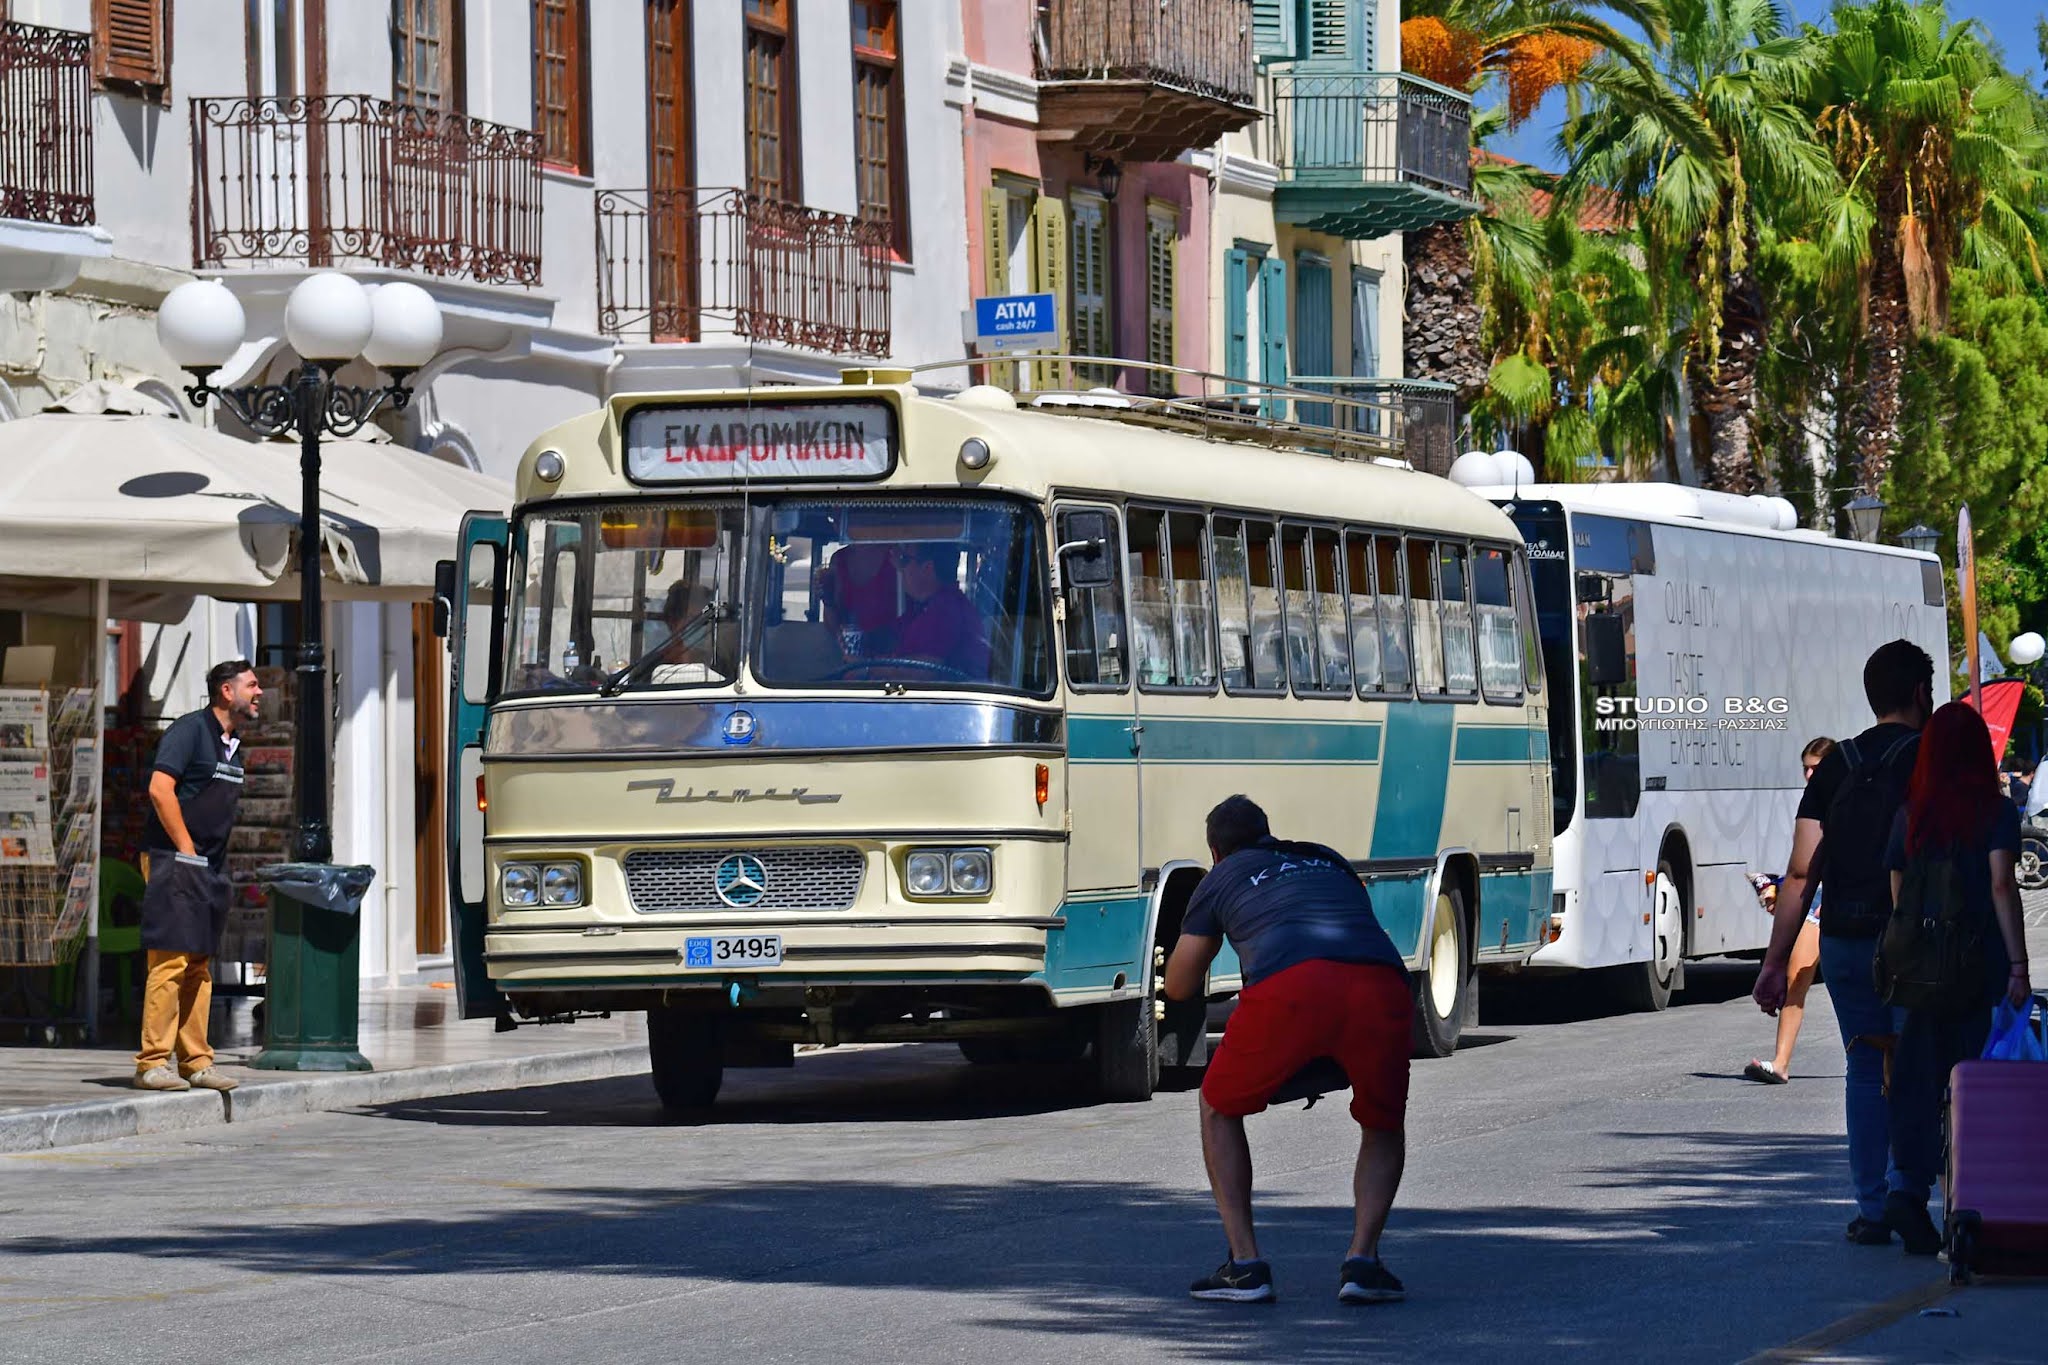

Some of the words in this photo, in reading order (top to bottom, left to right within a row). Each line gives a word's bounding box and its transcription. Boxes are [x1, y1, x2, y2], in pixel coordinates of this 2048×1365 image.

[995, 301, 1036, 320] ATM
[995, 321, 1014, 331] cash
[1016, 320, 1036, 331] 24/7
[665, 421, 865, 463] ΕΚΔΡΟΜΙΚΟΝ
[729, 716, 752, 734] B
[717, 938, 777, 959] 3495
